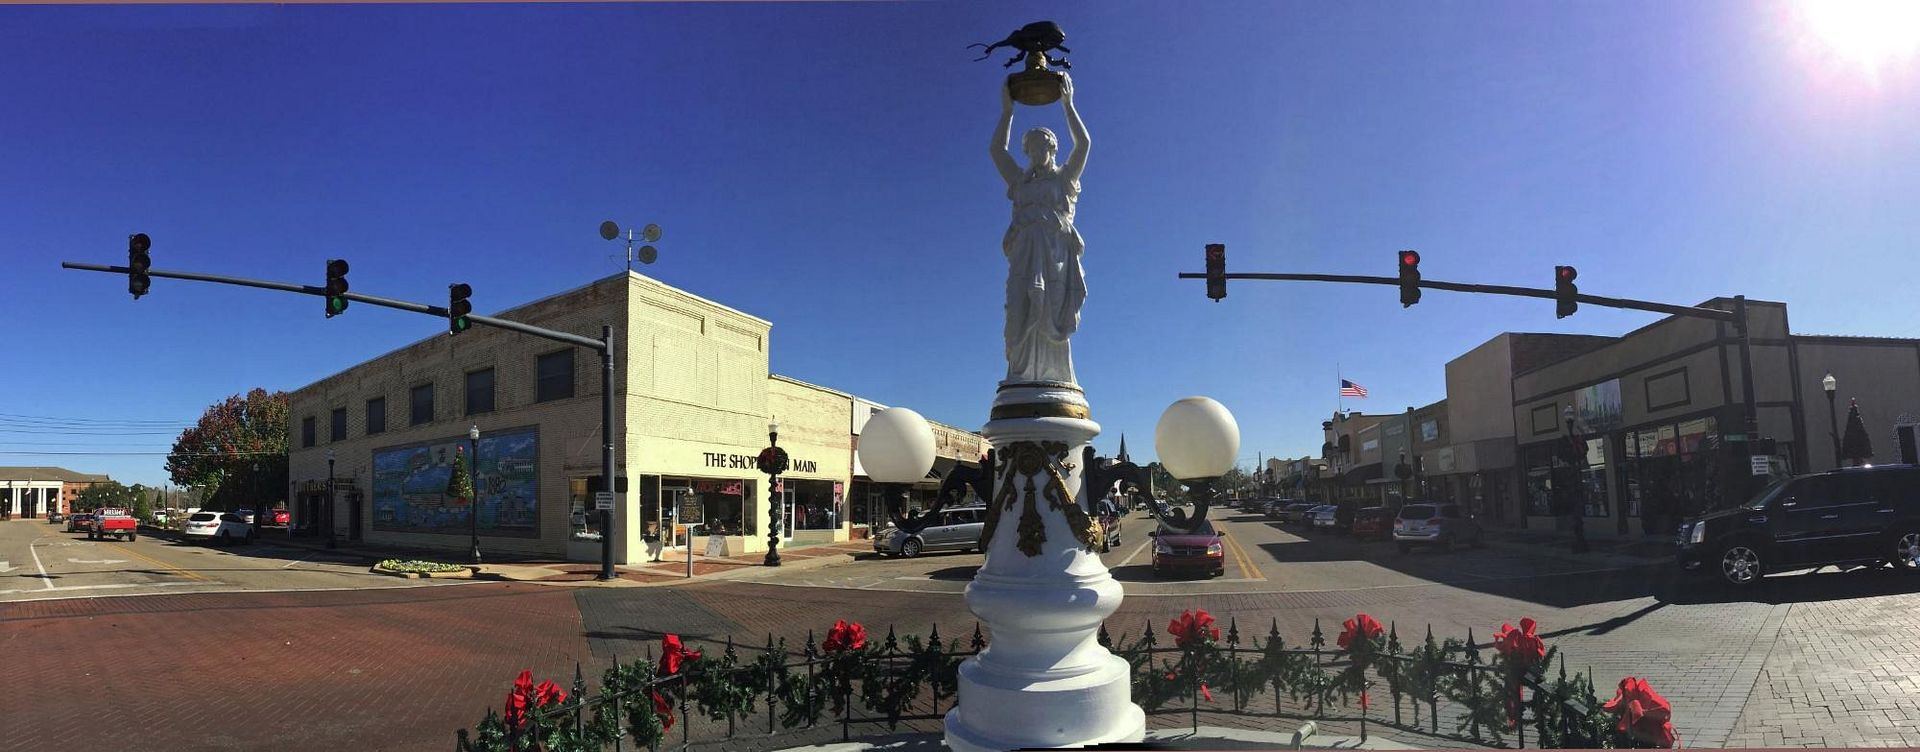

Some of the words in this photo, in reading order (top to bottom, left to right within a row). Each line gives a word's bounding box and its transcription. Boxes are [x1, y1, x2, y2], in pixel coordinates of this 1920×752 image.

[703, 452, 726, 468] THE
[729, 454, 760, 470] SHOP
[793, 458, 817, 473] MAIN
